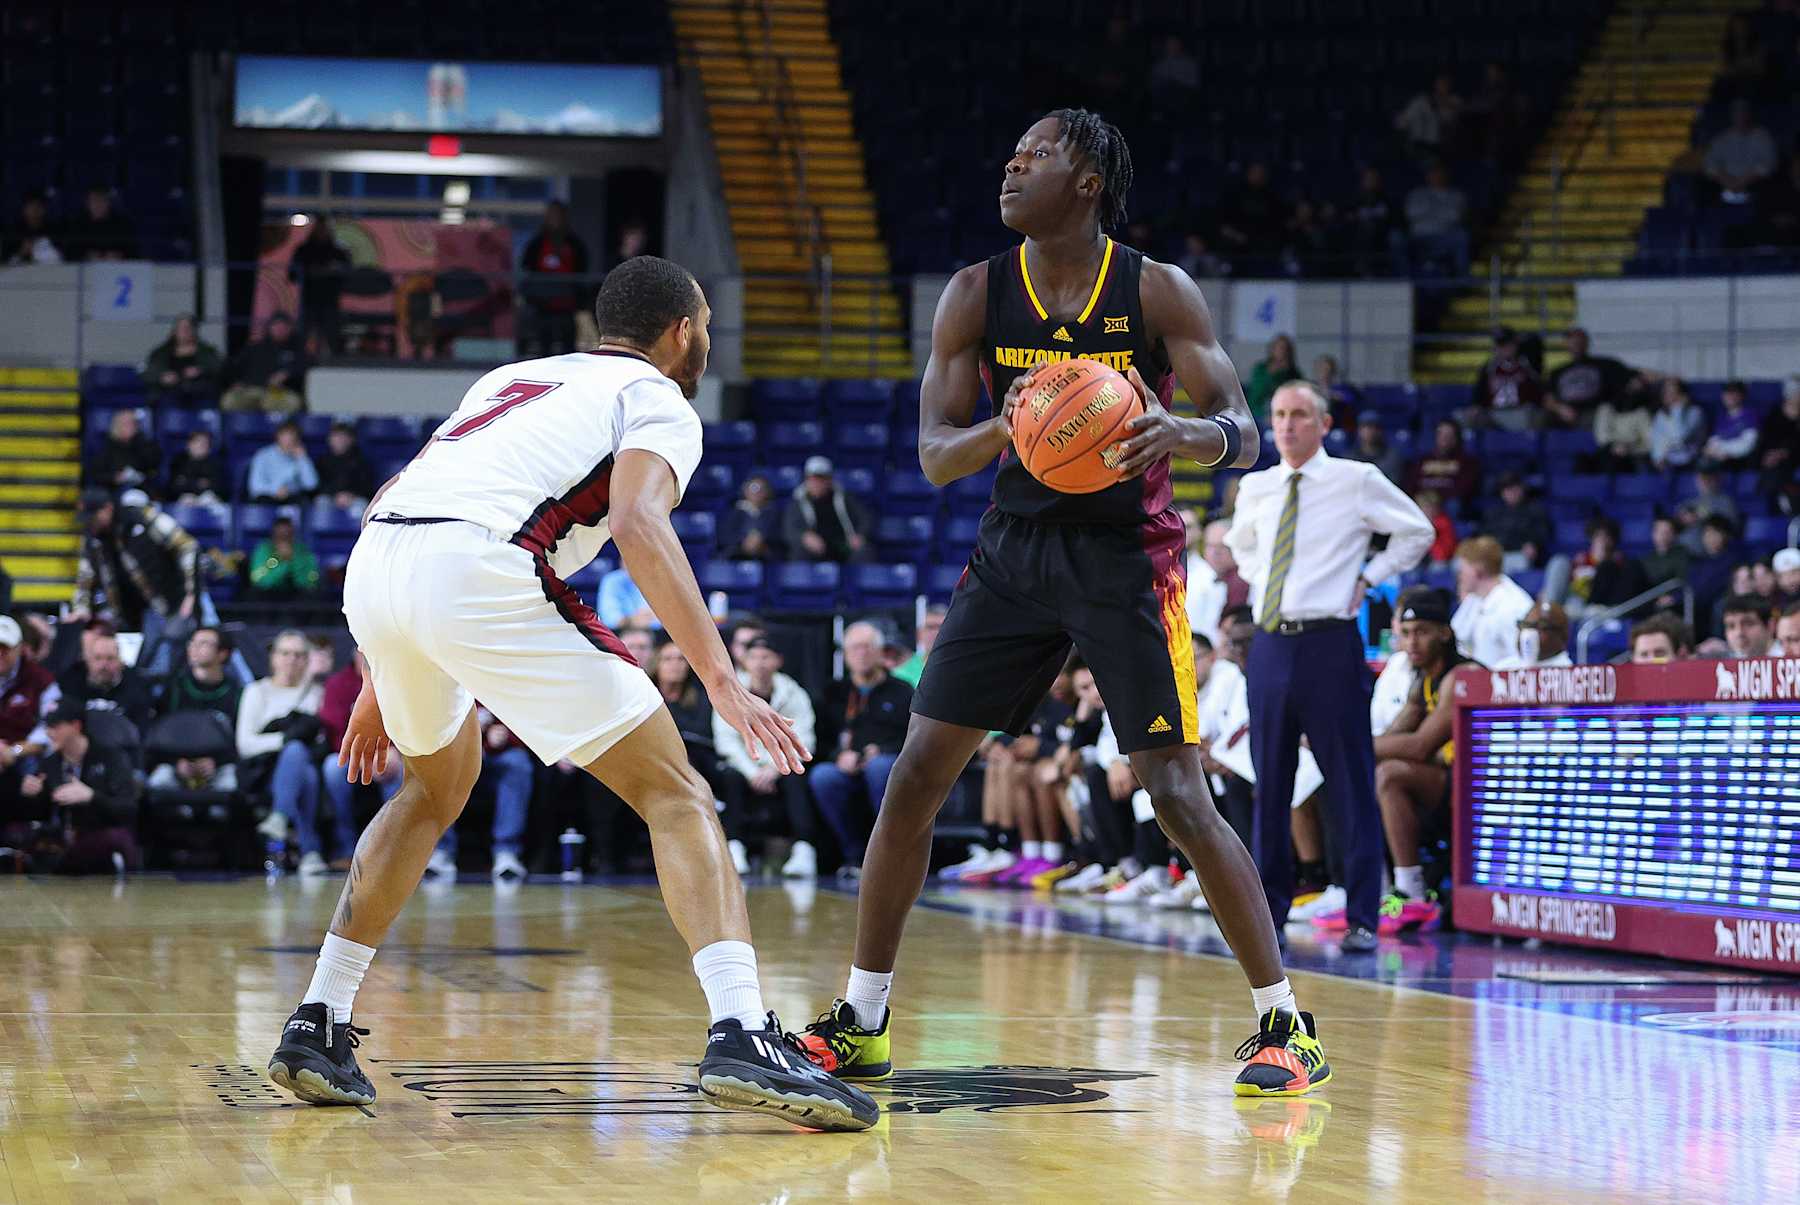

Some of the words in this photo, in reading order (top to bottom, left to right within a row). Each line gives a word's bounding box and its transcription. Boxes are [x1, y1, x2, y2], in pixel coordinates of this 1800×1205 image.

[113, 275, 134, 310] 2
[1255, 293, 1278, 328] 4
[438, 378, 565, 442] 7
[1046, 382, 1121, 453] SPALDING
[1508, 669, 1537, 704] MGM
[1538, 665, 1617, 704] SPRINGFIELD
[1738, 660, 1773, 700] MGM
[1509, 894, 1538, 929] MGM
[1539, 896, 1617, 941] SPRINGFIELD
[1736, 919, 1773, 960] MGM
